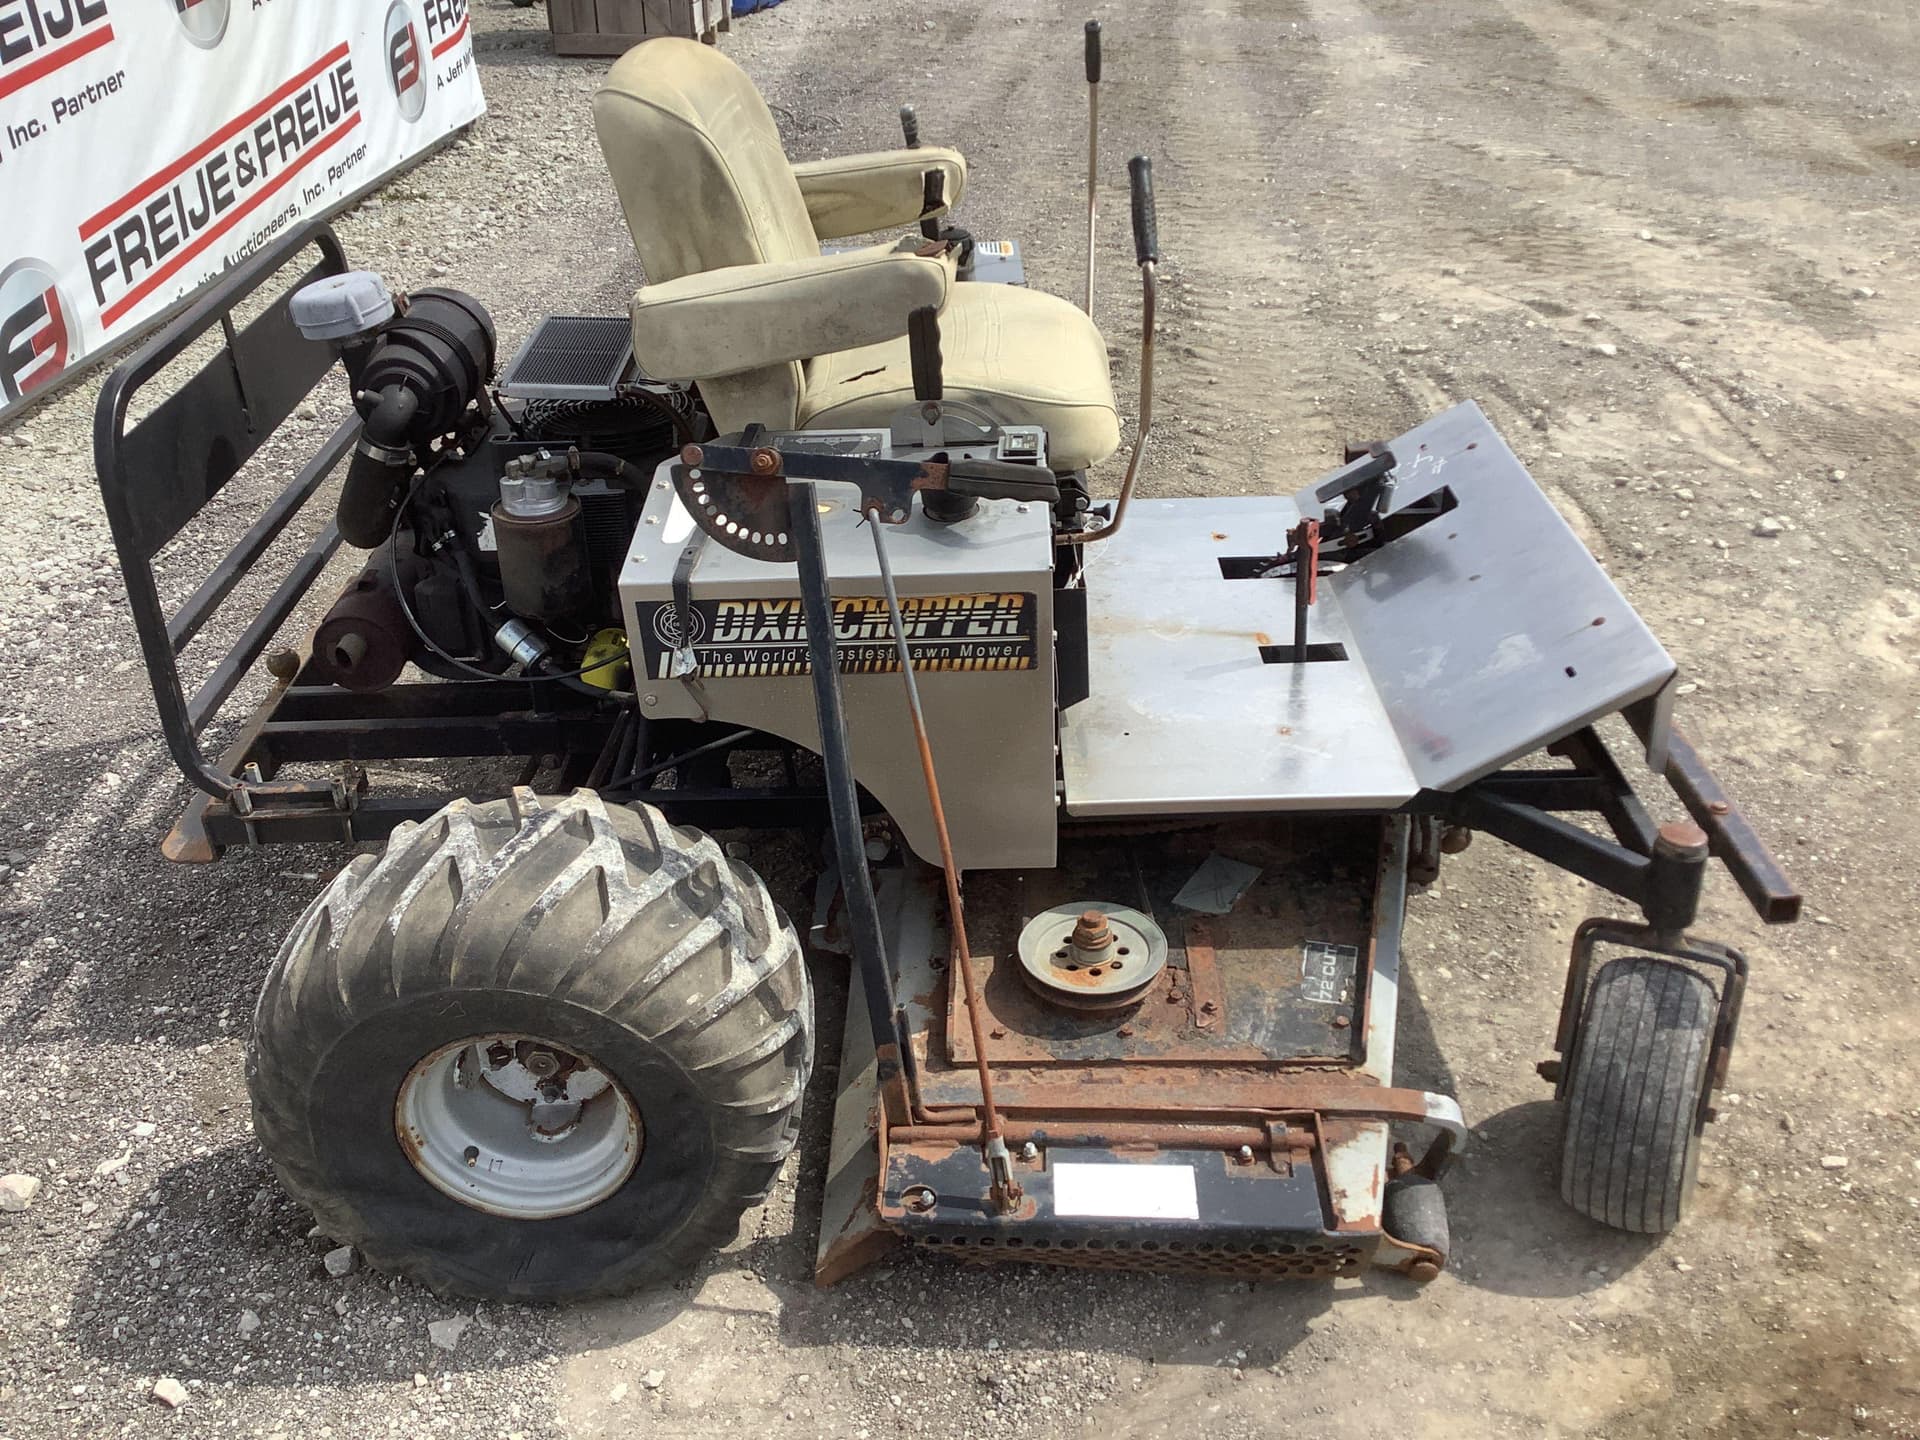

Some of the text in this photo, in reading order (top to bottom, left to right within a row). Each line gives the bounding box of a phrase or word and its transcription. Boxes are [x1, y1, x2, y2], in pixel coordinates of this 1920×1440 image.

[437, 59, 464, 90] A Jeff
[6, 69, 125, 150] Inc. Partner
[303, 182, 325, 205] Inc.
[328, 143, 366, 186] Partner
[700, 644, 1021, 664] The World's astest awn Mower
[1322, 945, 1337, 976] CUT
